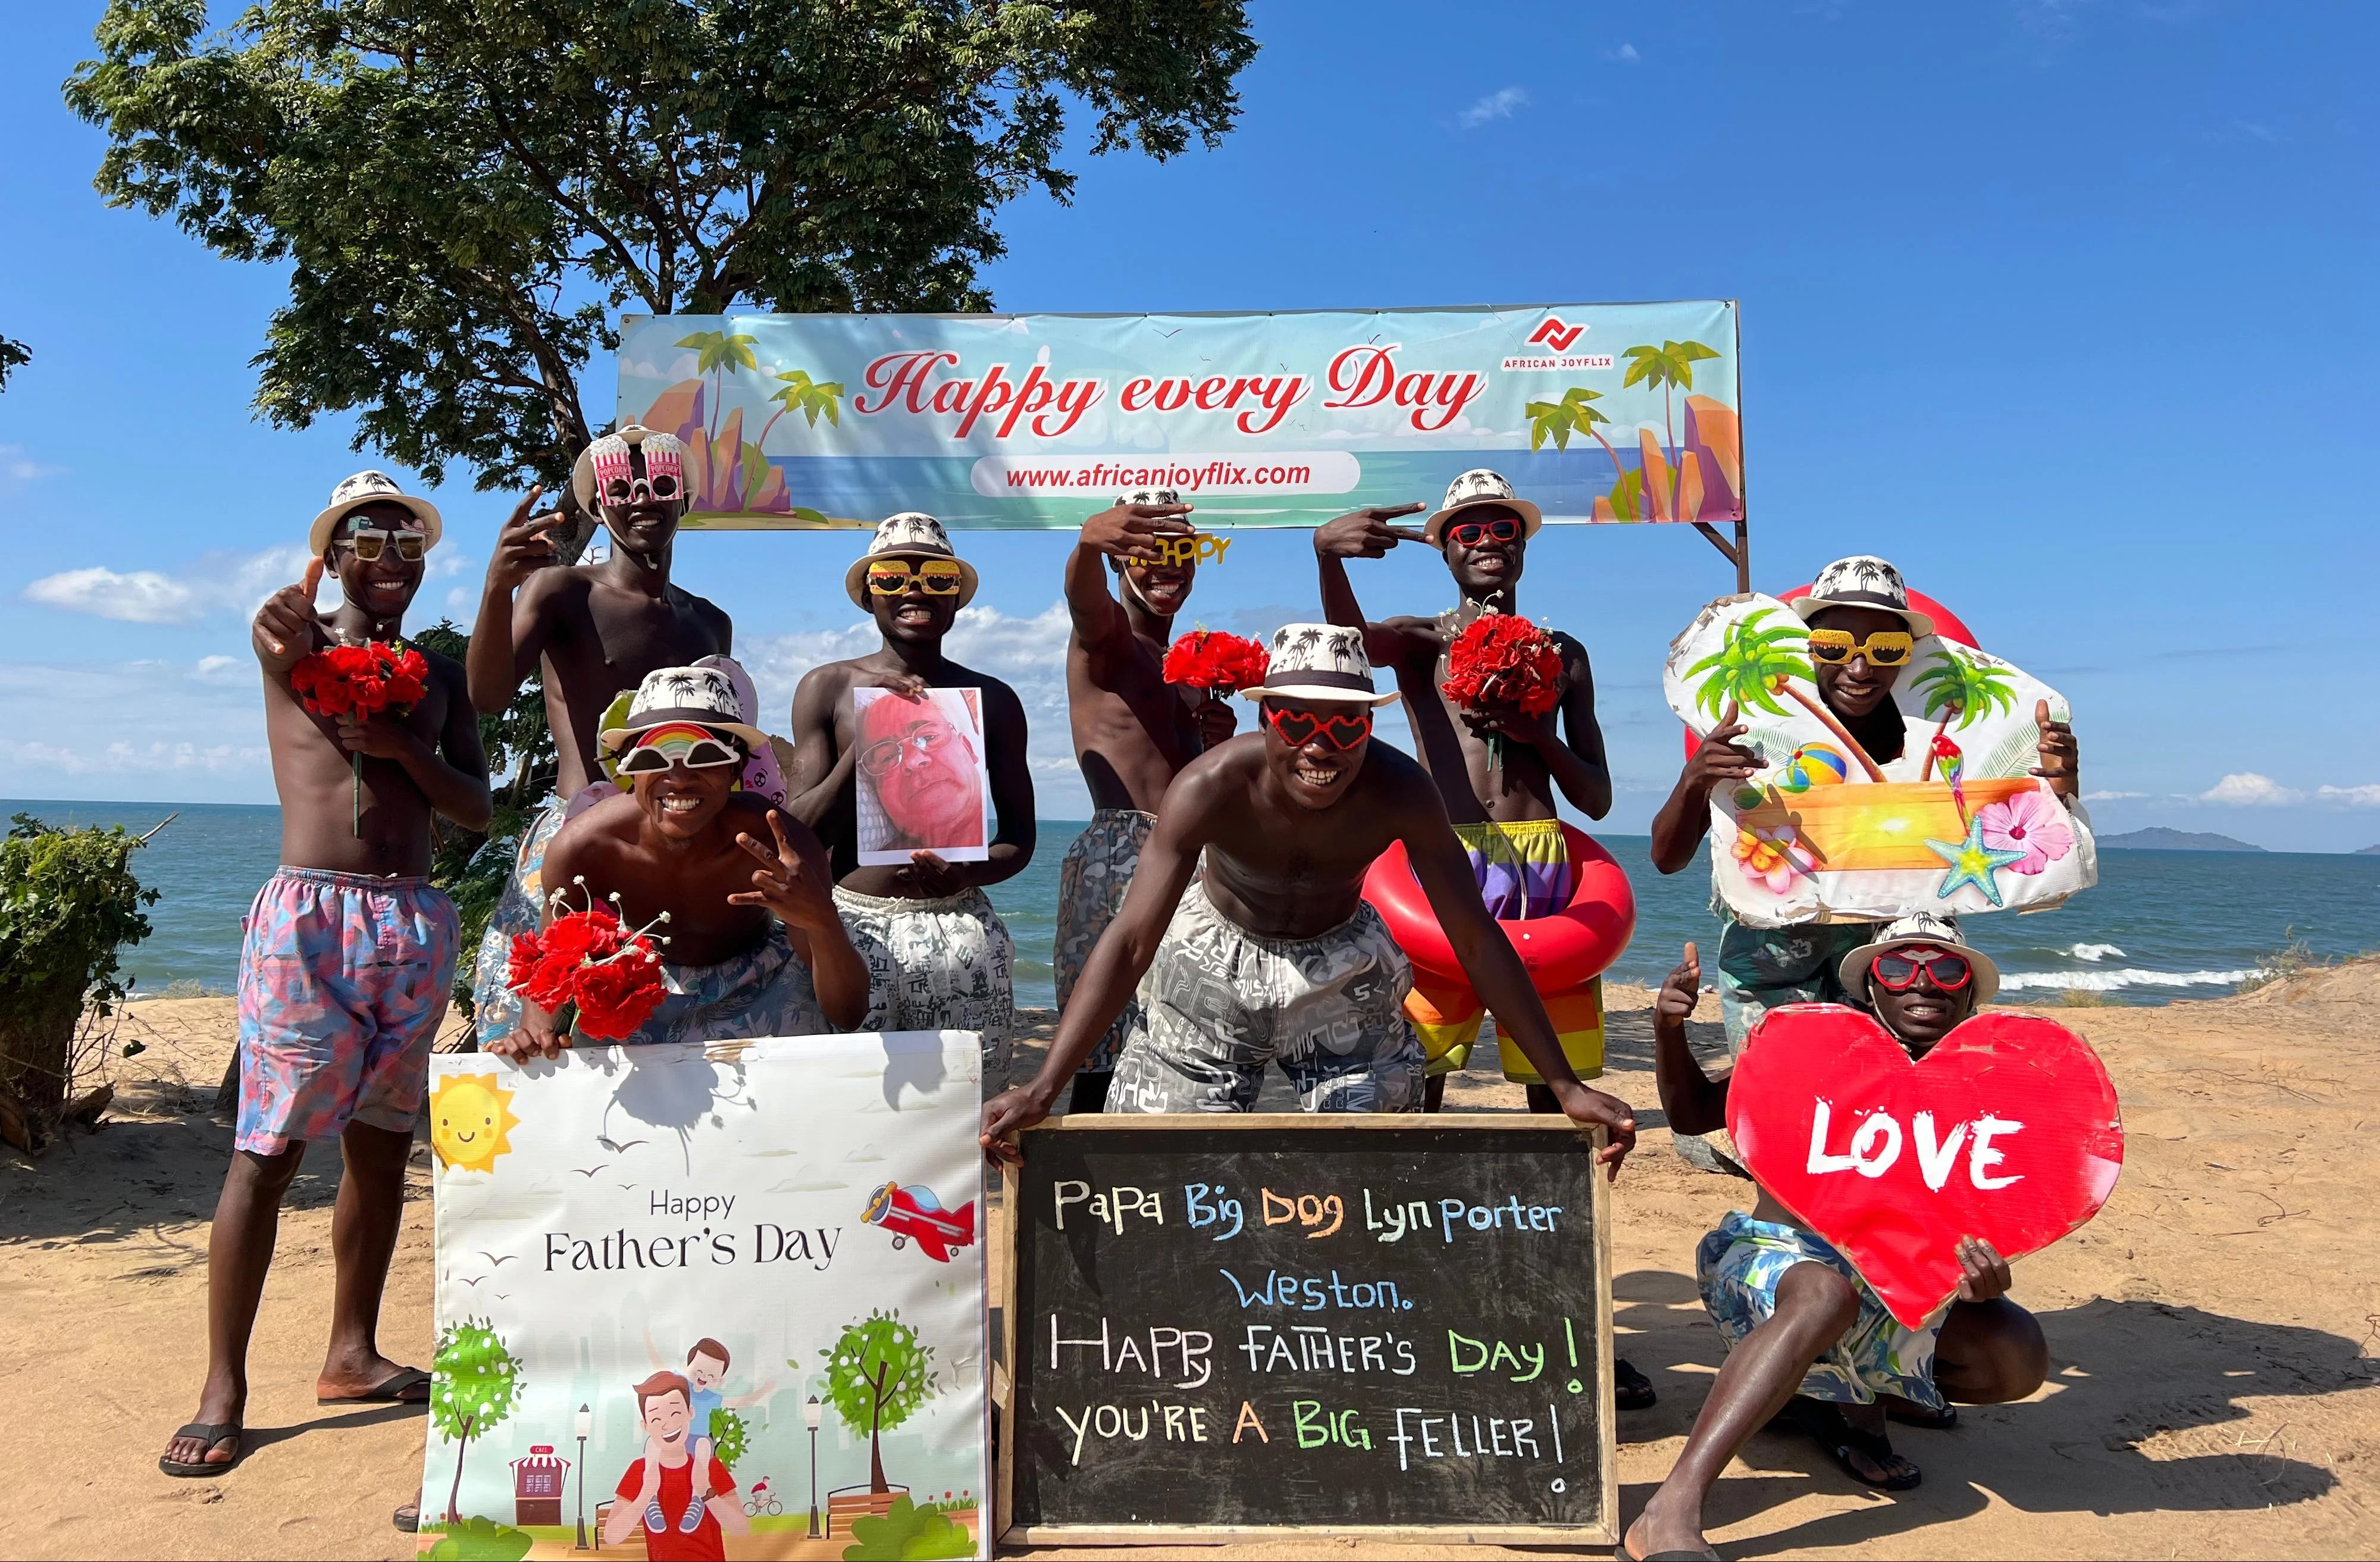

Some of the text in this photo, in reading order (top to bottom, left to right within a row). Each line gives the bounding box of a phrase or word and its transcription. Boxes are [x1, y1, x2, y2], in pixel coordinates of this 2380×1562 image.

[1504, 358, 1611, 368] AFRICAN JOYFLIX
[856, 345, 1484, 439] Happy every Day
[599, 465, 629, 477] POPCORN
[651, 464, 678, 474] POPCORN
[1007, 461, 1310, 492] www.africanjoyflix.com
[1806, 1096, 2025, 1193] LOVE
[650, 1189, 737, 1222] Happy
[1184, 1182, 1244, 1241] Big
[1363, 1188, 1433, 1242] Lyn
[544, 1224, 843, 1272] Father's Day
[1220, 1269, 1414, 1311] Weston.
[1238, 1325, 1416, 1375] FATHER'S
[1232, 1400, 1270, 1444] A
[1292, 1400, 1372, 1451] BIG
[1387, 1403, 1567, 1494] FELLER!
